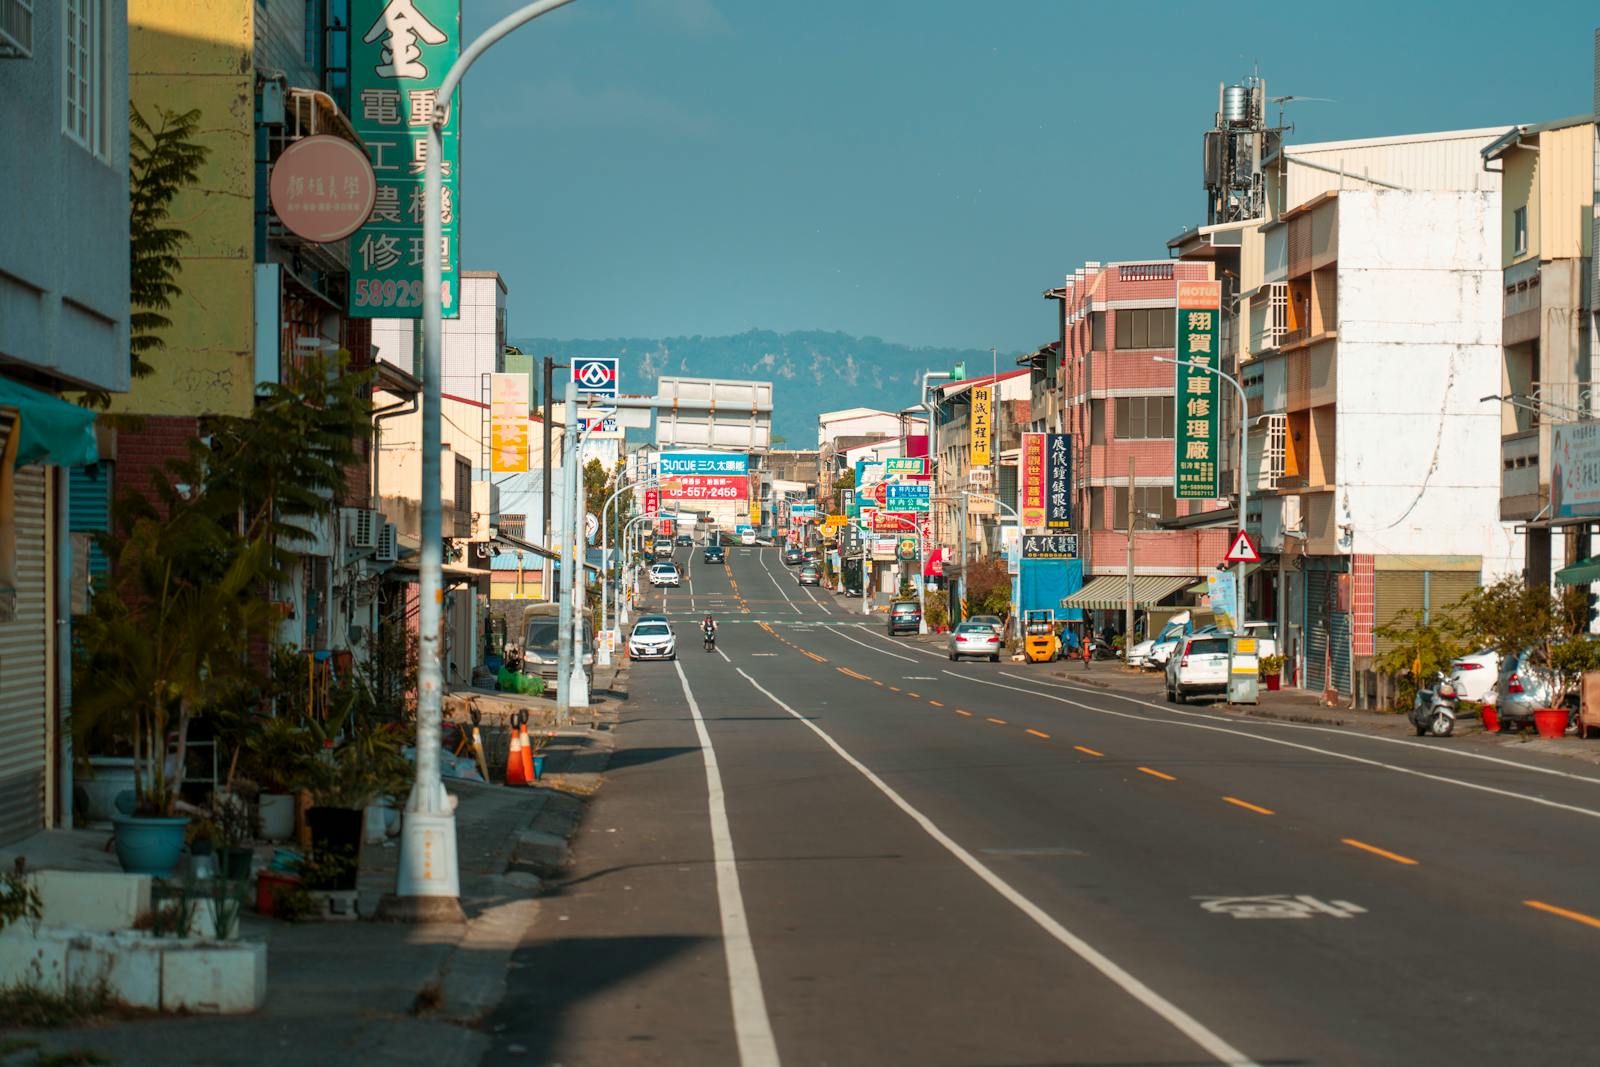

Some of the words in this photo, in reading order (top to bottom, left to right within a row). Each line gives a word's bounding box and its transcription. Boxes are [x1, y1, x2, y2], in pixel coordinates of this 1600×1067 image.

[362, 0, 448, 79] 金
[360, 89, 450, 127] 電動
[356, 280, 451, 308] 589294
[1186, 312, 1211, 459] 翔賀汽車修理廠
